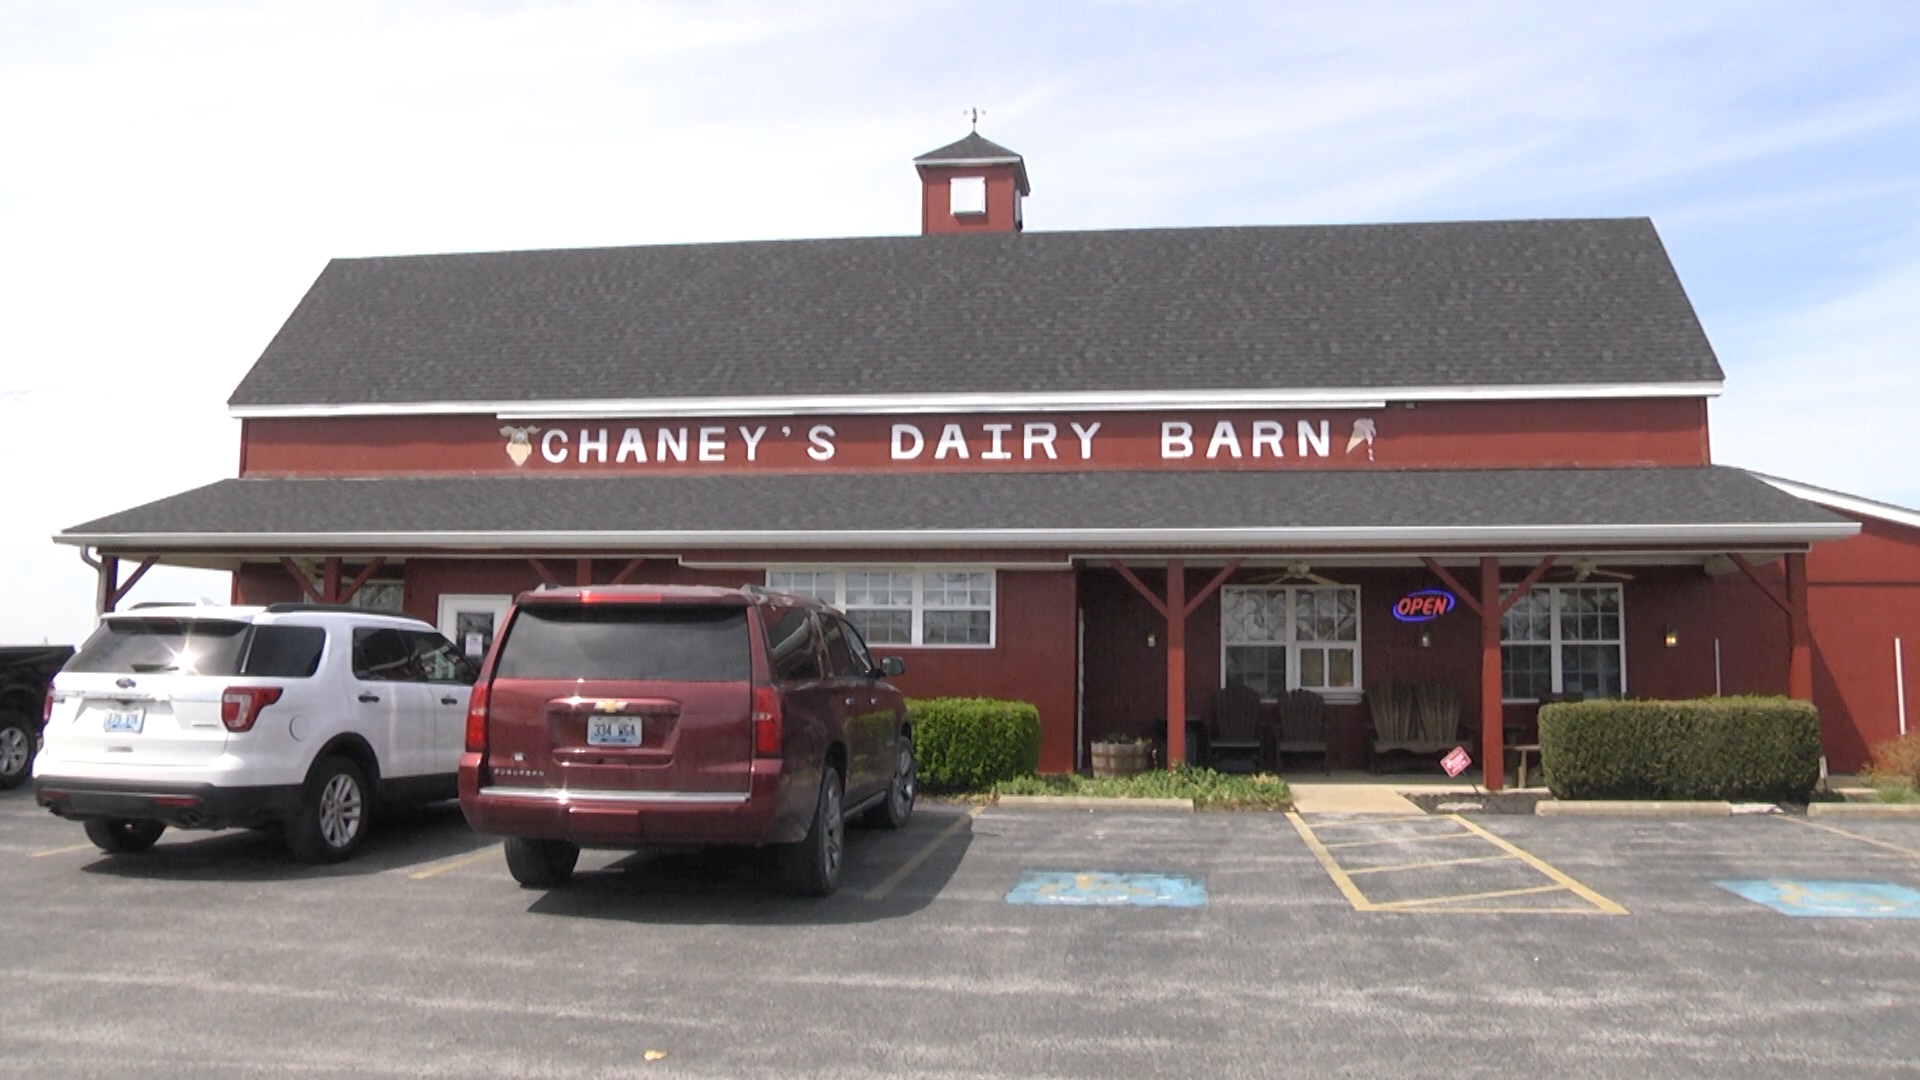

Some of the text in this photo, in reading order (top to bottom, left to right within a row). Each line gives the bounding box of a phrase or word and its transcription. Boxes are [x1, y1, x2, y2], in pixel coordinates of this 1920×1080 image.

[541, 420, 1330, 463] CHANEY'S DAIRY BARN
[1397, 597, 1448, 615] OPEN
